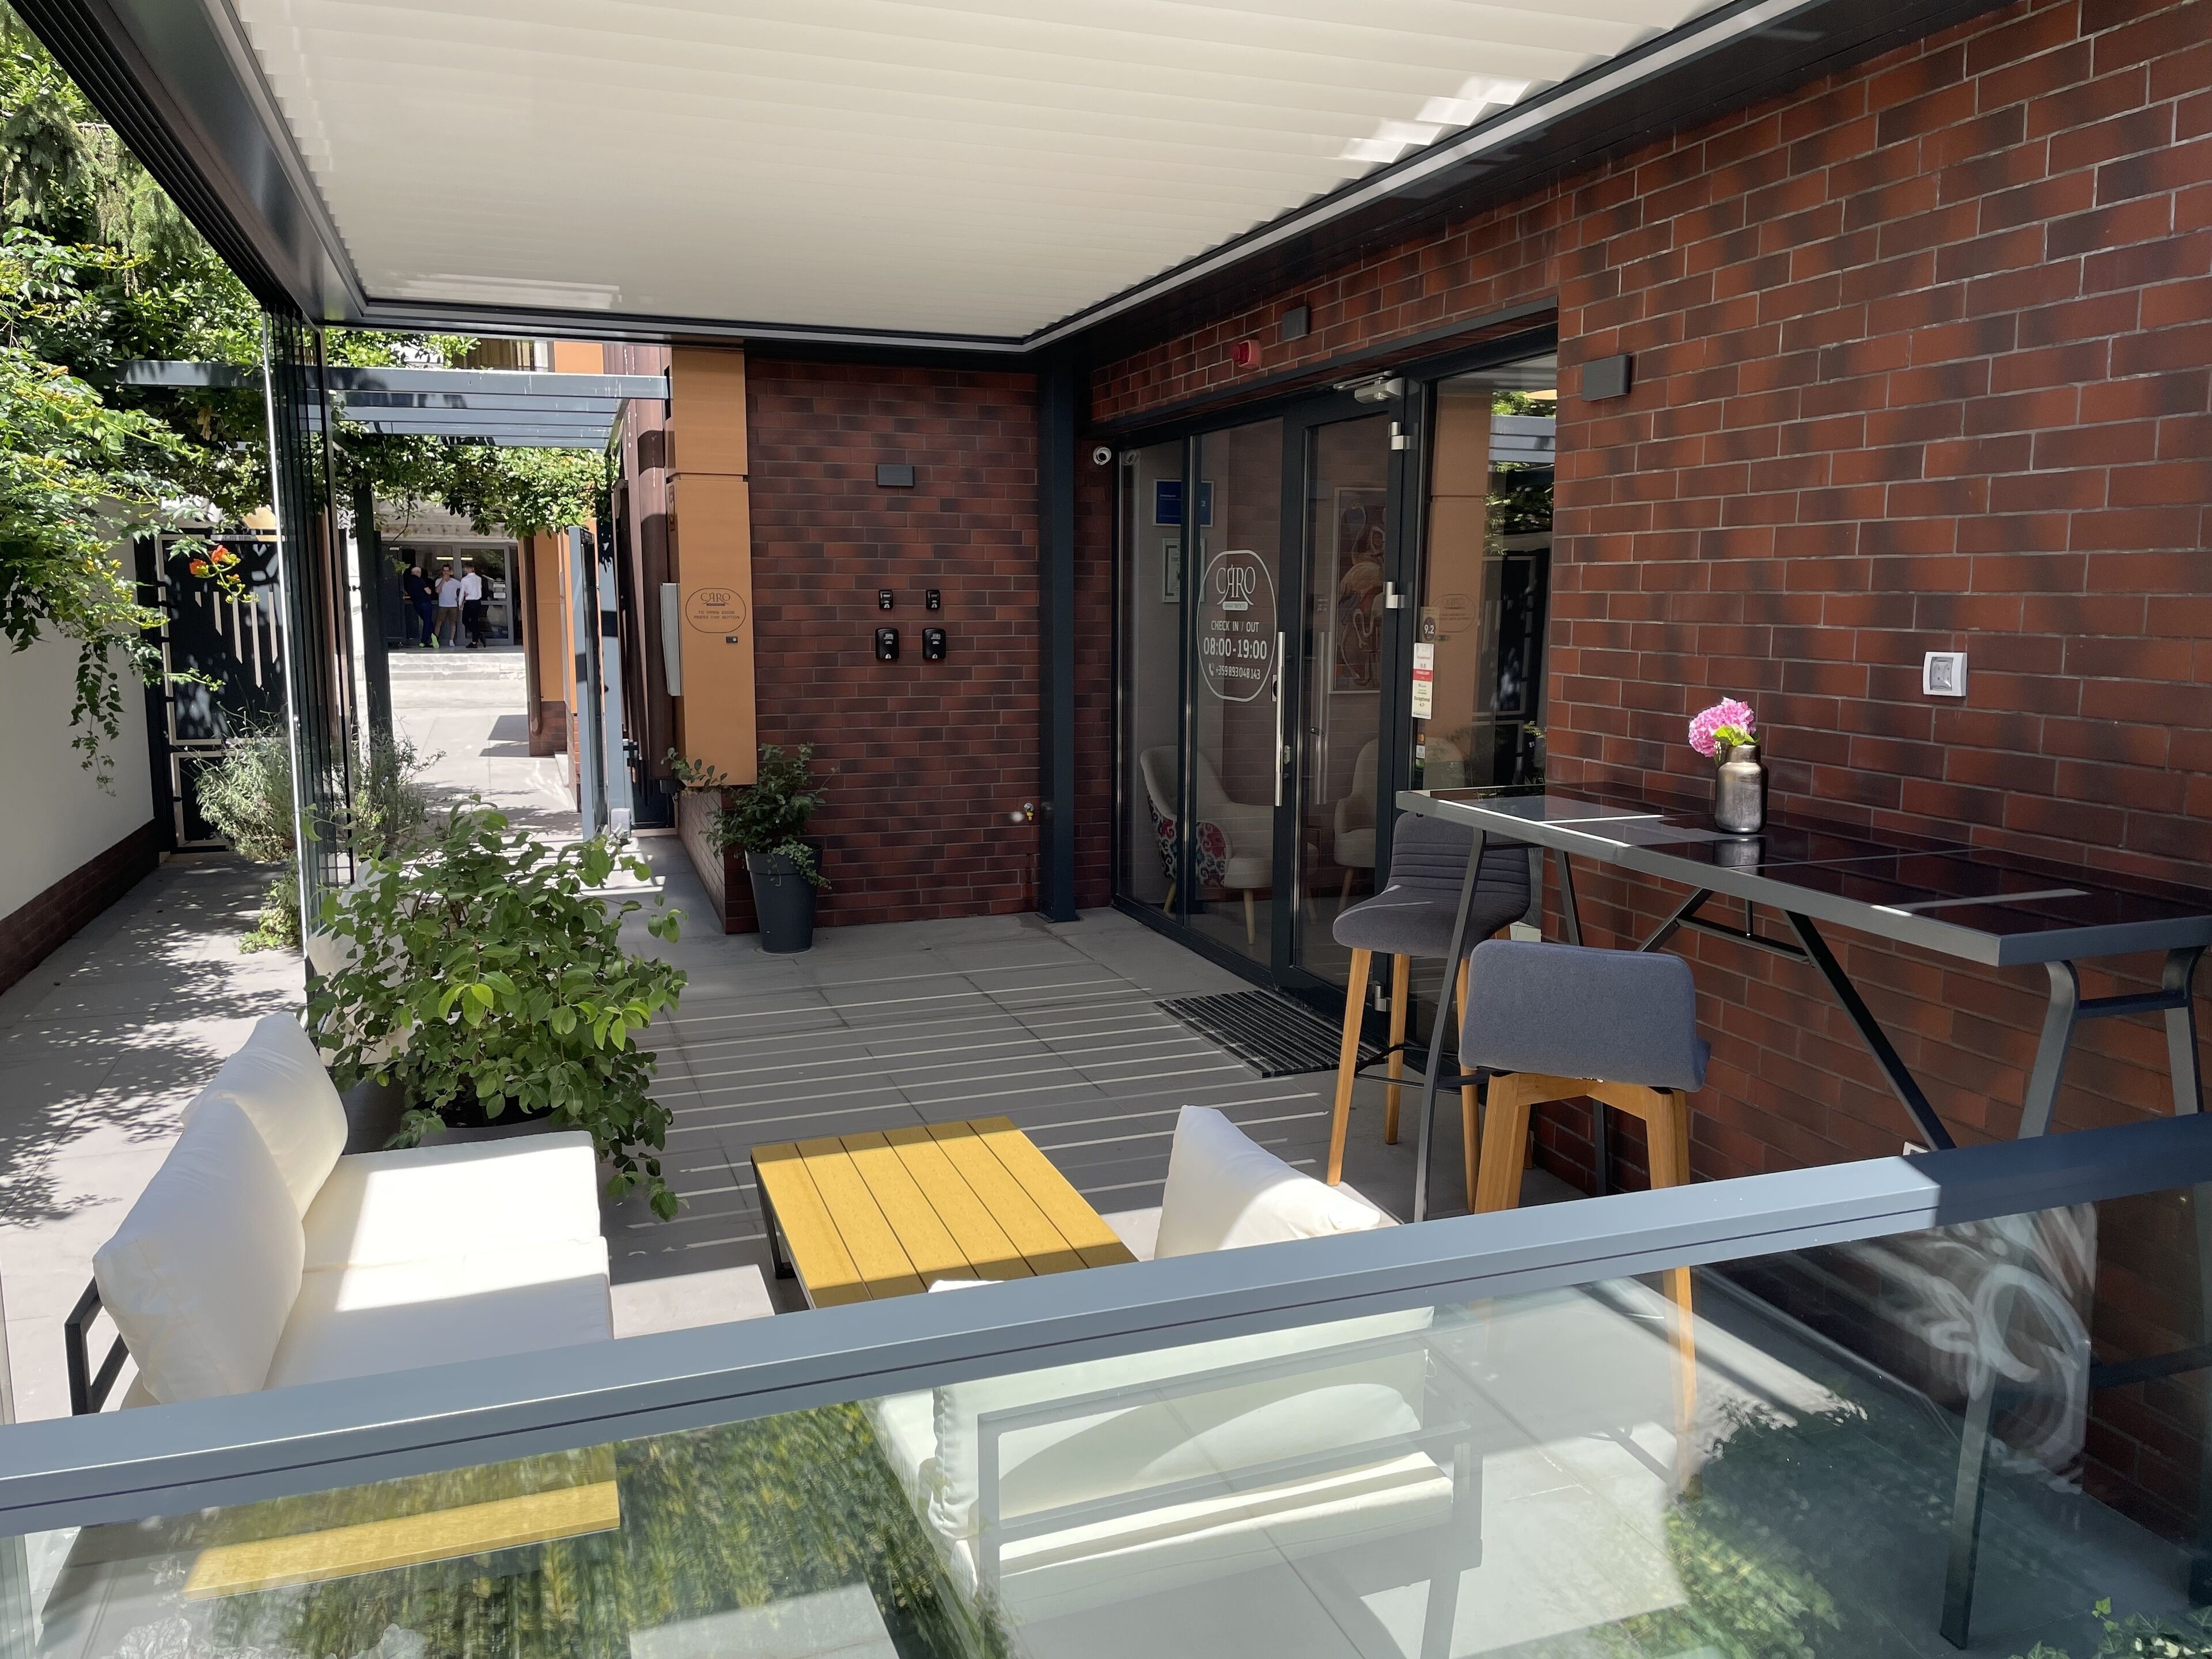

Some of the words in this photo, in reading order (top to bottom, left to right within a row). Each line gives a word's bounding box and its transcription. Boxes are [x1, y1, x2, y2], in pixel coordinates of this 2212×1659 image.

[1211, 620, 1230, 631] CHECK
[1232, 621, 1239, 632] IN
[1246, 622, 1259, 632] OUT
[1424, 624, 1434, 634] 9.2
[1203, 637, 1267, 660] 08:00-19:00
